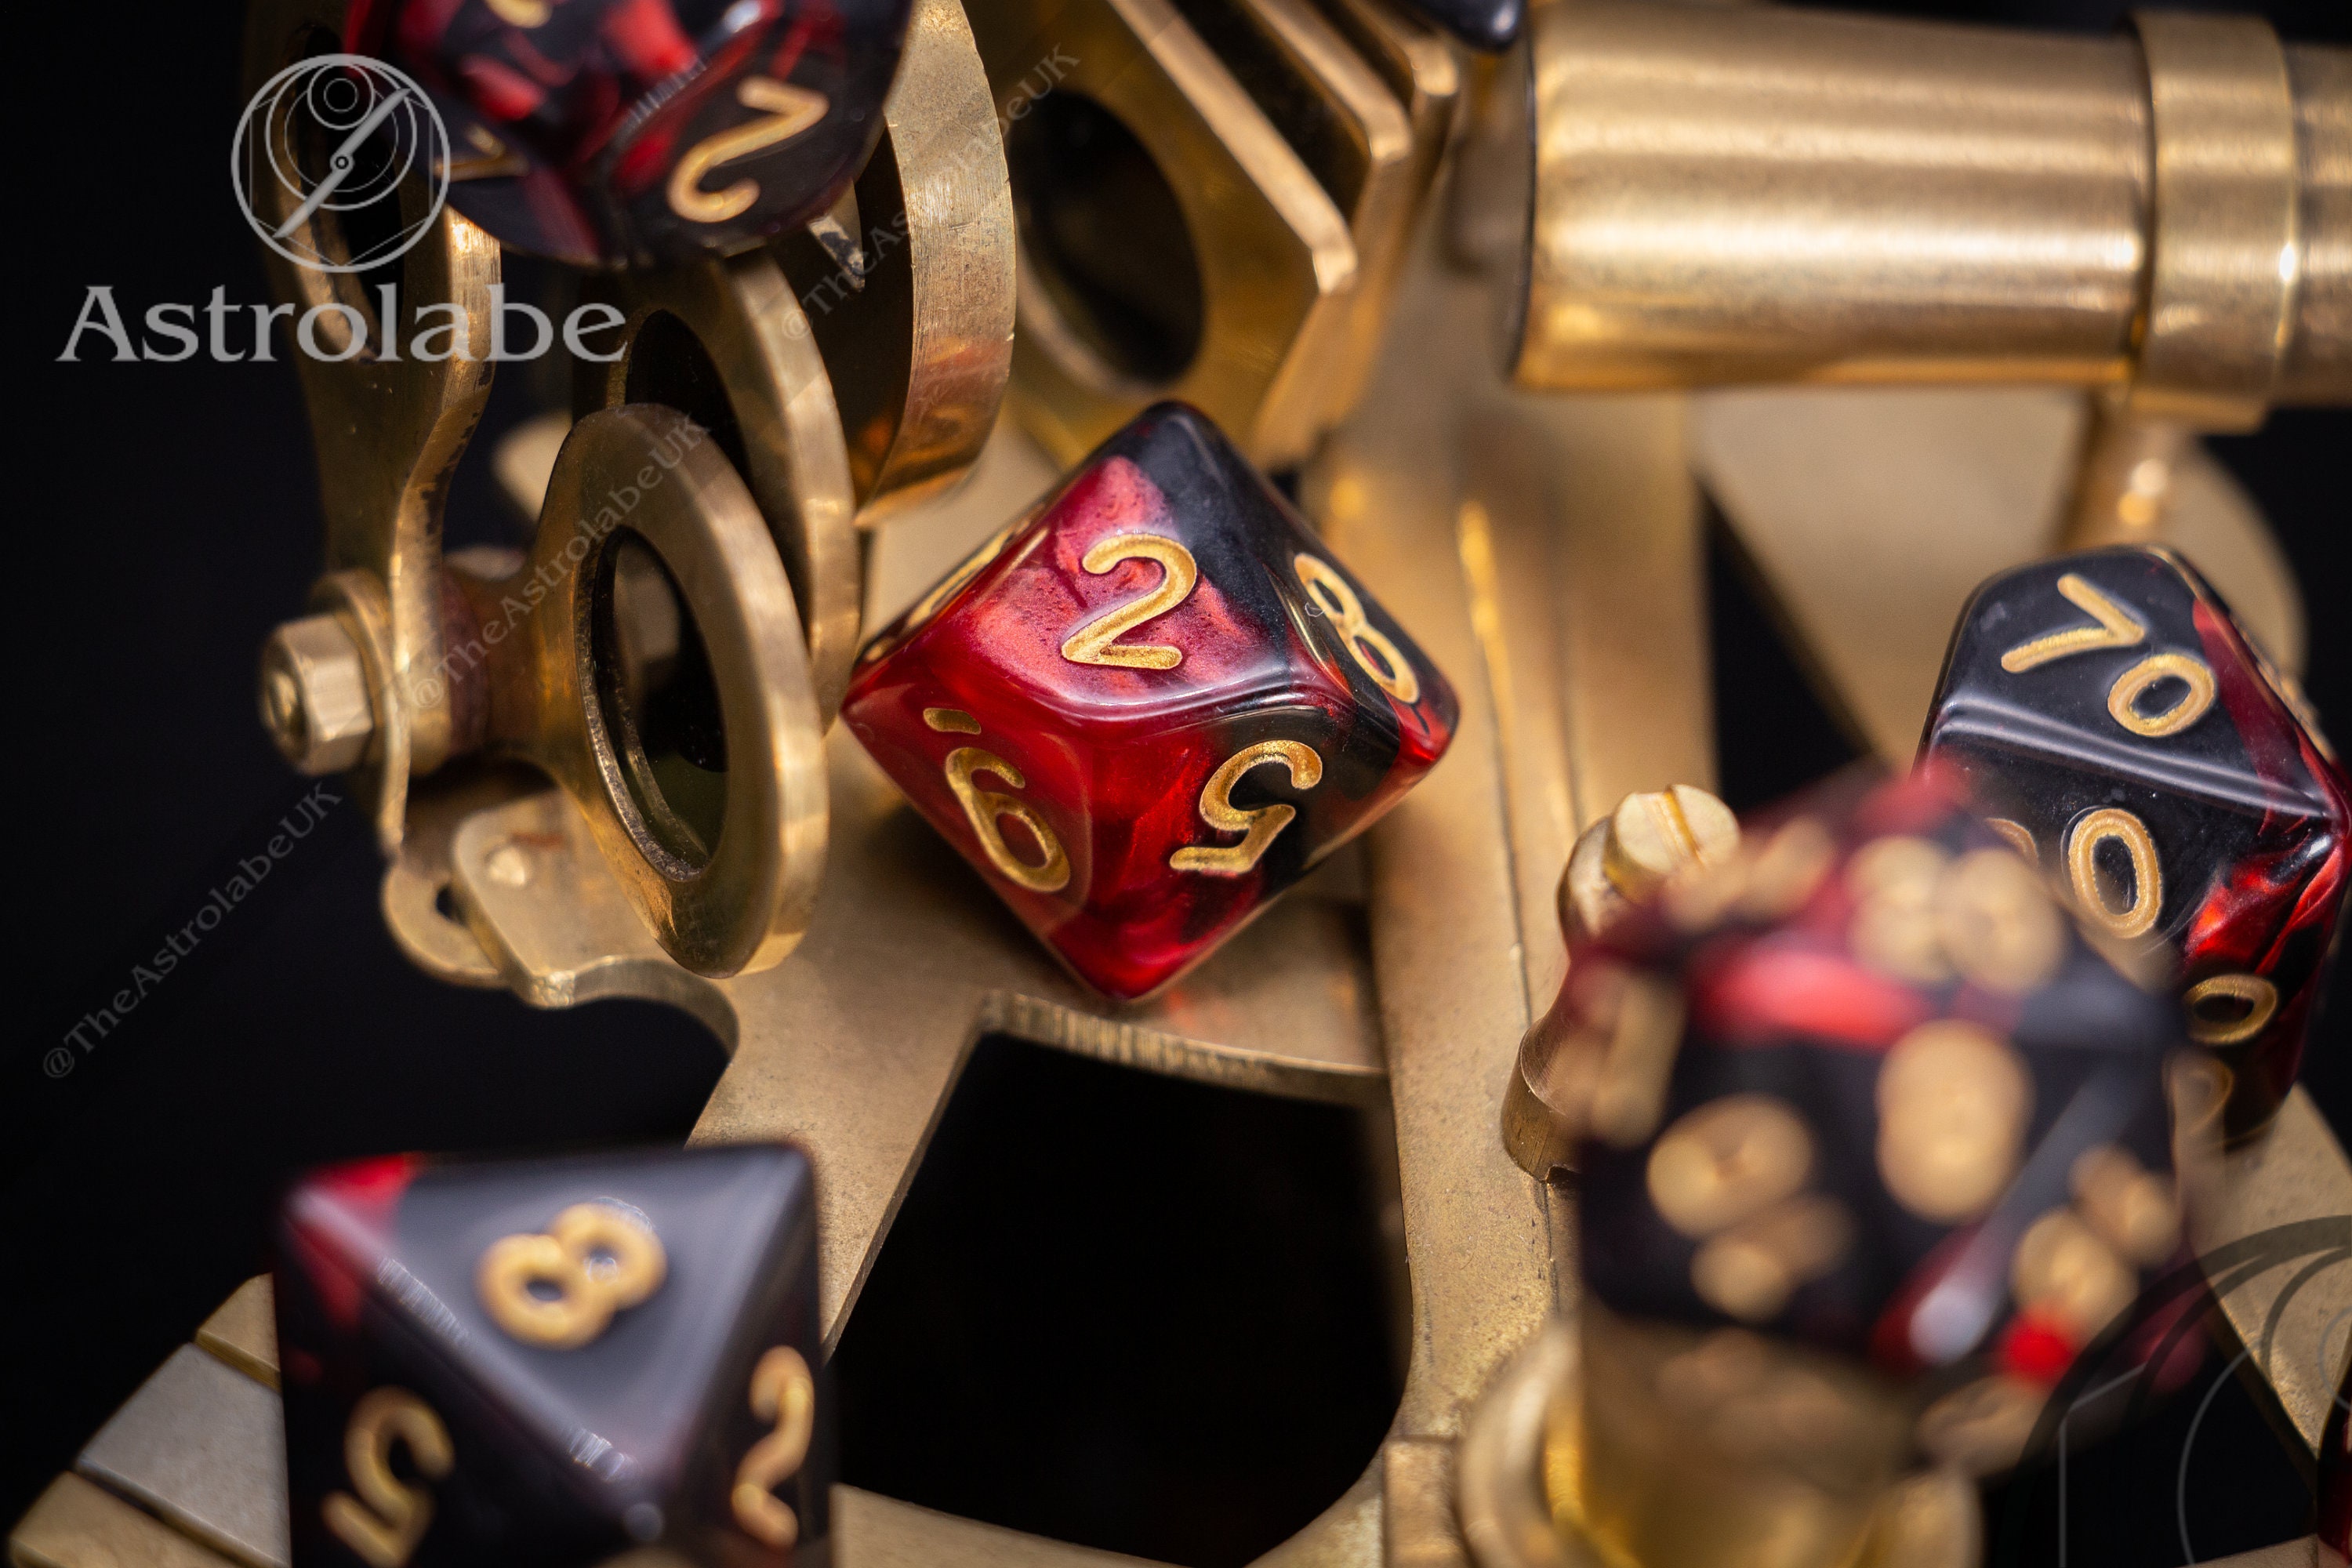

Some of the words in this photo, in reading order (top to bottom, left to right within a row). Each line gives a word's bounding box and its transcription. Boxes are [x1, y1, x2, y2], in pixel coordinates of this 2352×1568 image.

[1061, 532, 1198, 670] 2
[1292, 552, 1421, 705] 8
[1169, 739, 1323, 875] 5
[478, 1201, 668, 1352] 8
